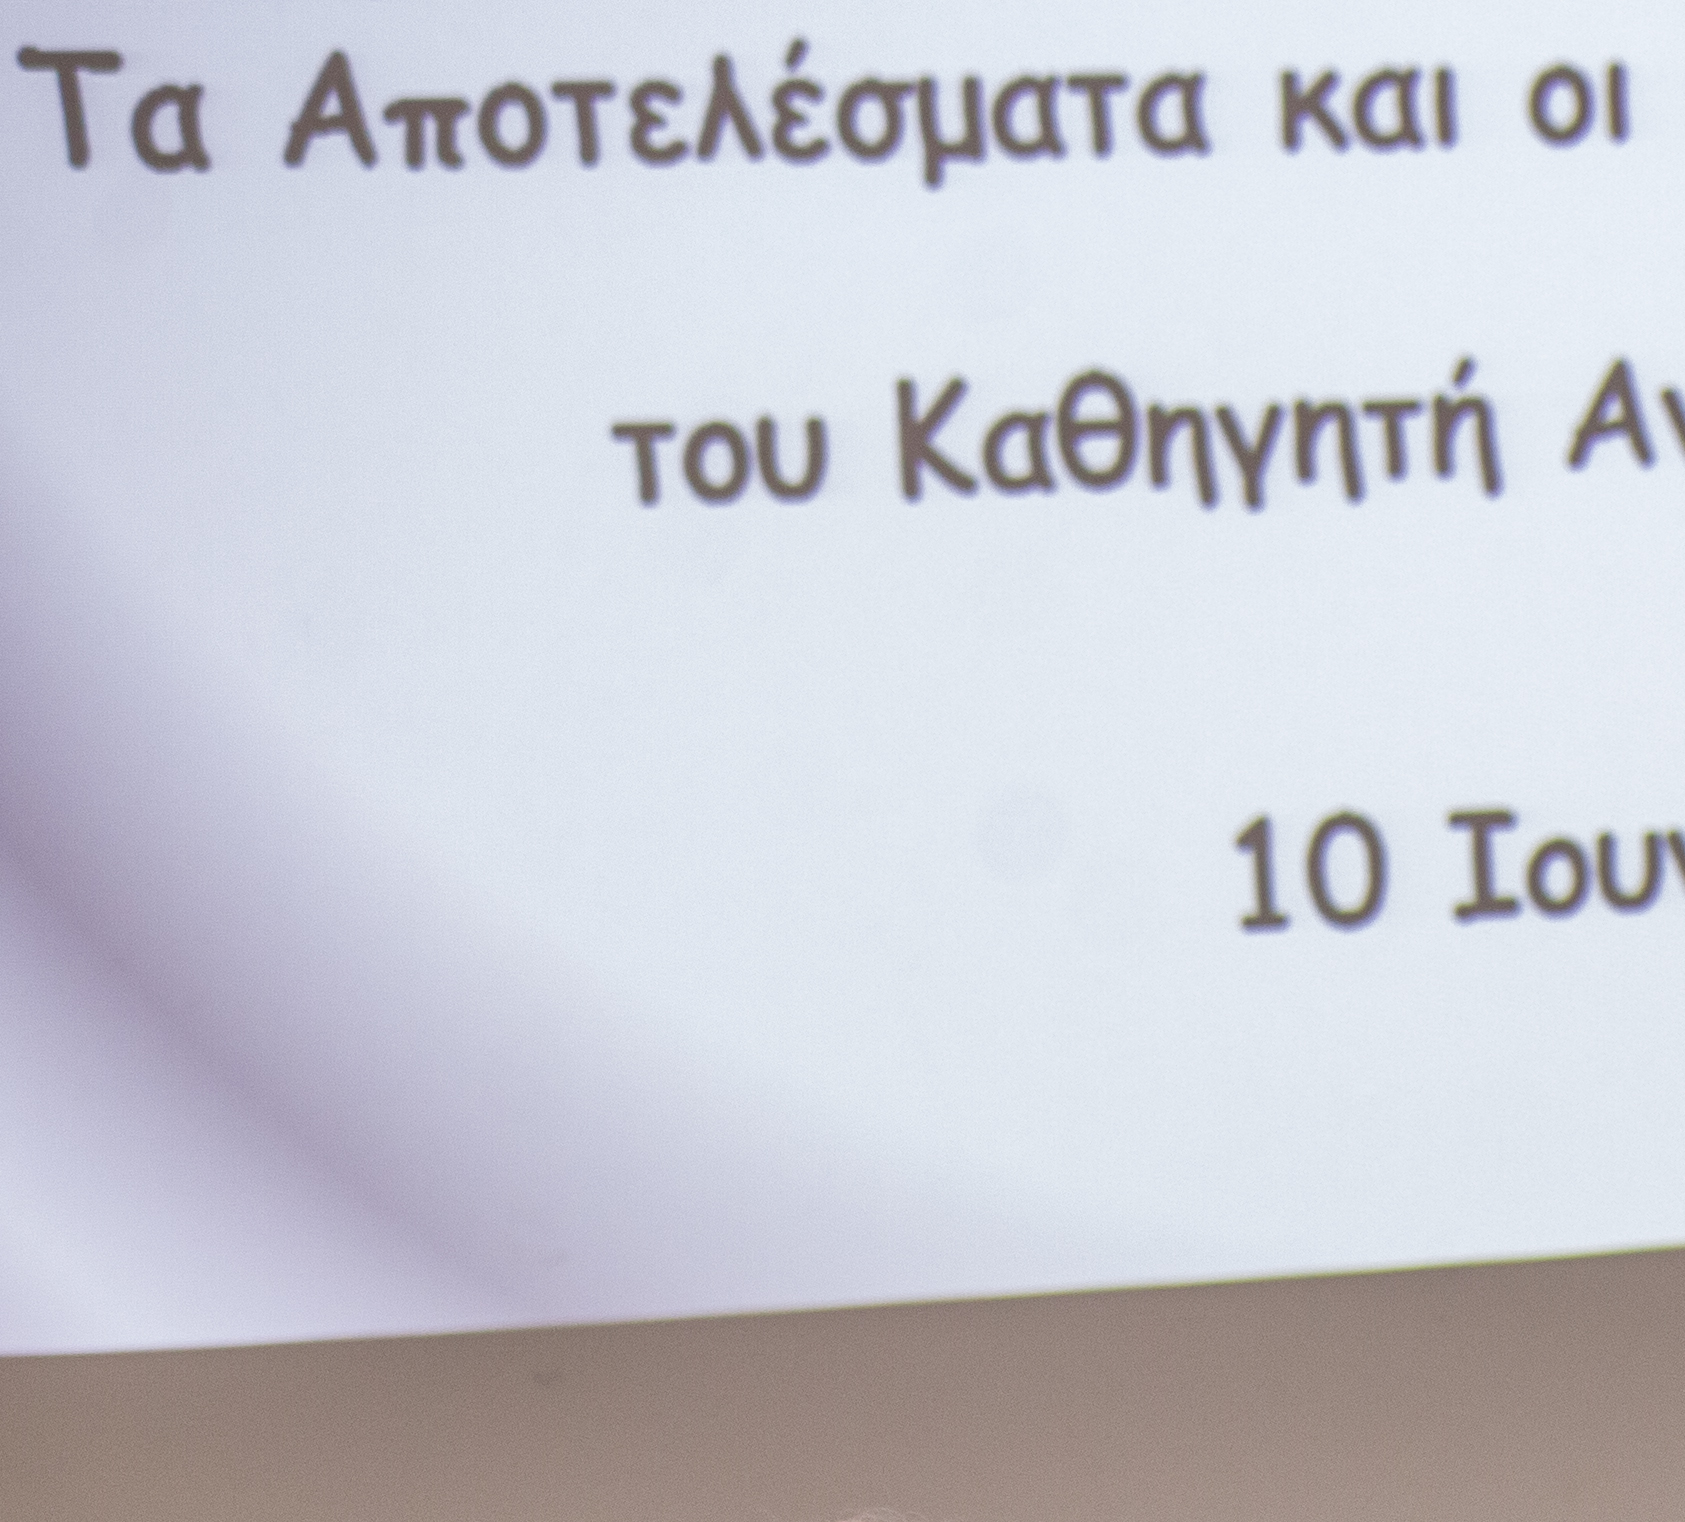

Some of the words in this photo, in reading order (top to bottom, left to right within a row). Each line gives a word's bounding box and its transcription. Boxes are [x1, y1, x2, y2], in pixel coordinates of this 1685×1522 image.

[14, 44, 213, 176] Τα
[279, 36, 1213, 192] Αποτελέσματα
[1277, 64, 1460, 155] και
[1526, 60, 1632, 150] οι
[608, 413, 831, 509] του
[893, 355, 1506, 514] Καθηγητή
[1233, 808, 1391, 934] 10
